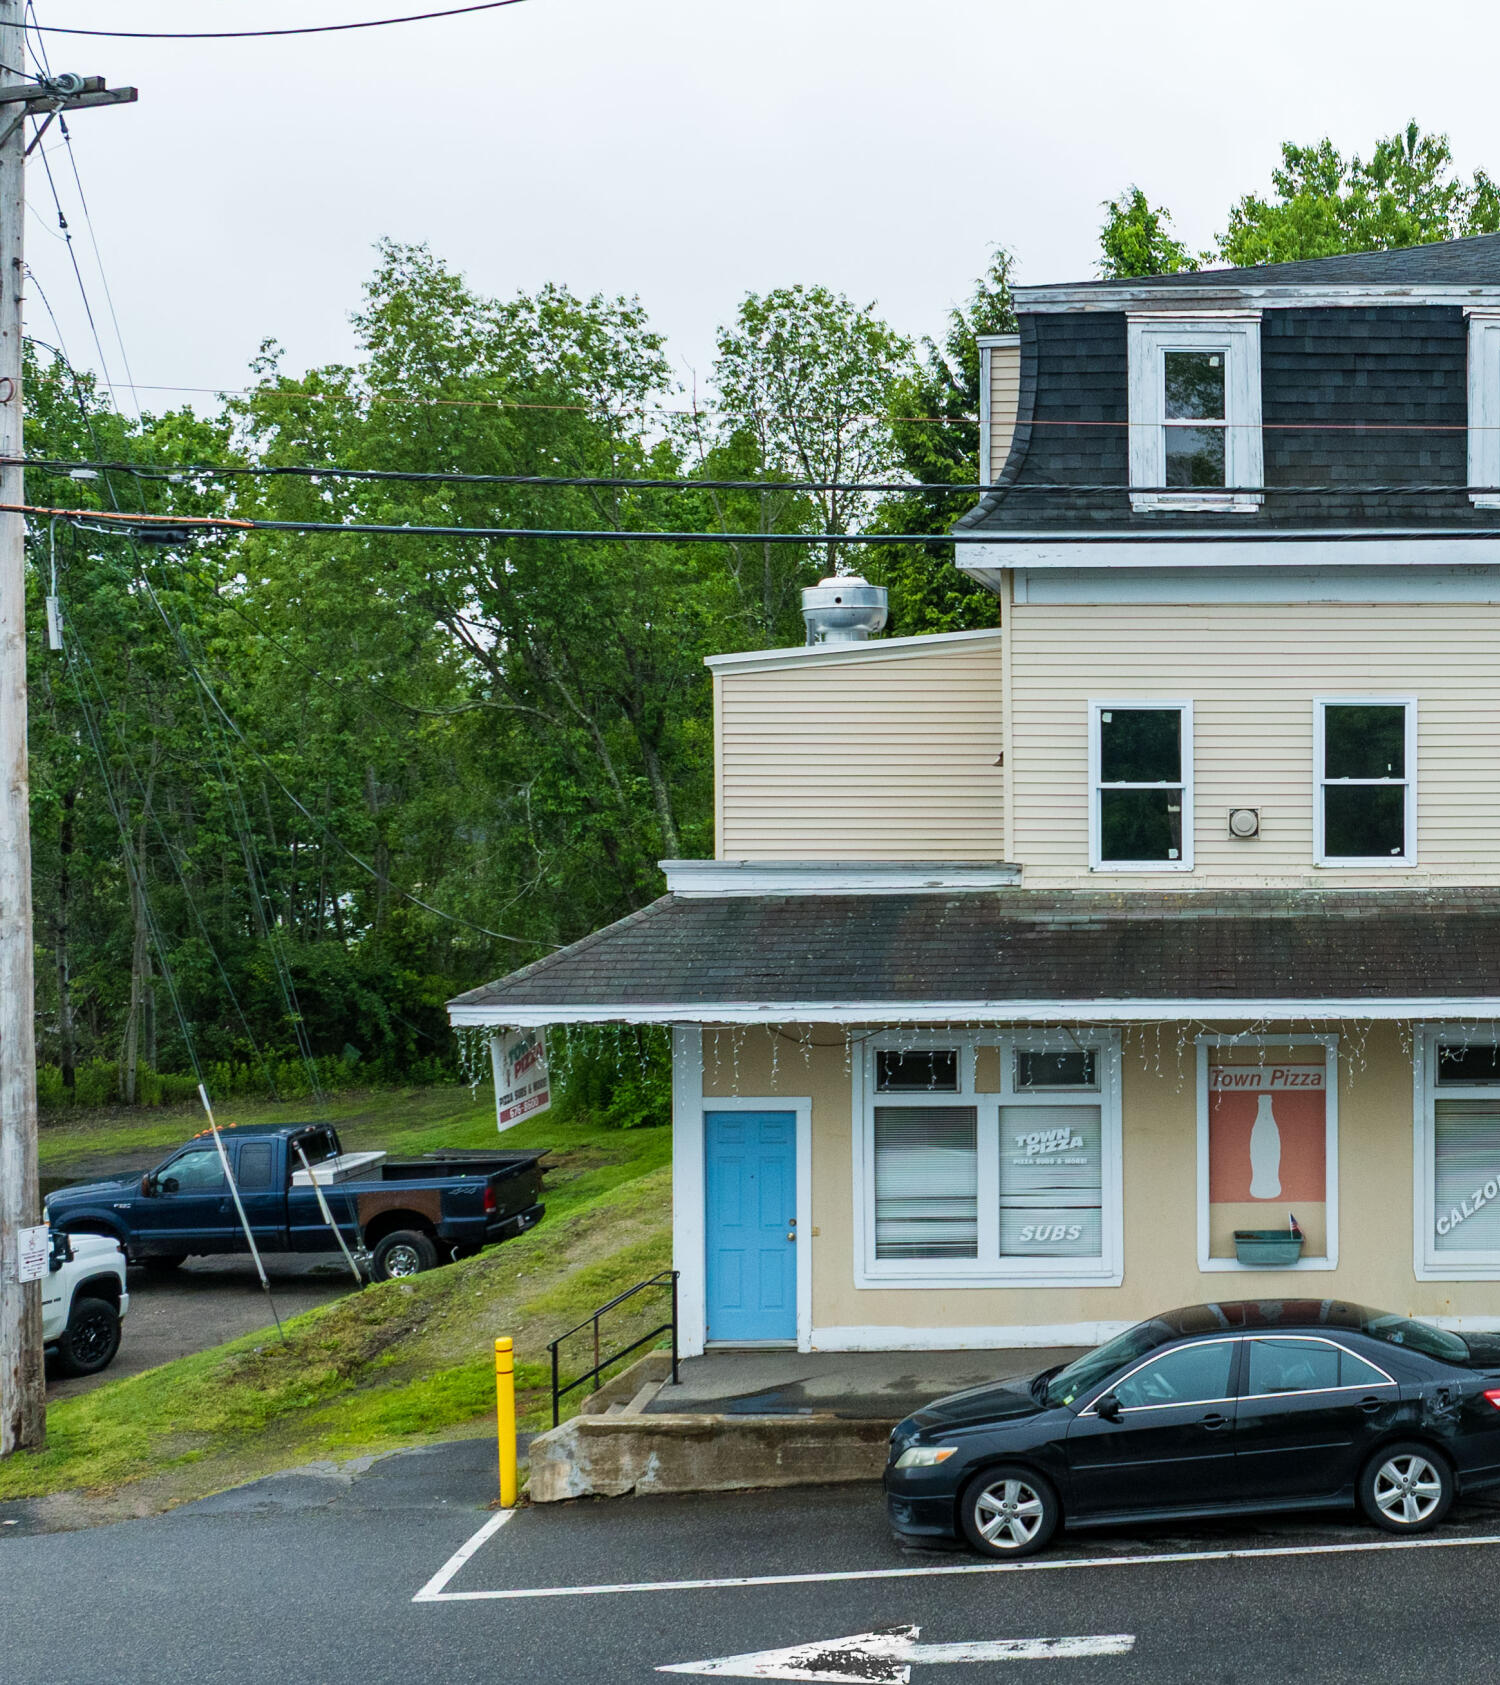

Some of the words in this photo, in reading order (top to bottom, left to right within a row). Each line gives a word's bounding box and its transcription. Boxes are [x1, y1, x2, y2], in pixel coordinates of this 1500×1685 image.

[1212, 1069, 1262, 1087] Town
[1270, 1069, 1322, 1087] Pizza
[1015, 1127, 1071, 1147] TOWN
[1026, 1136, 1083, 1156] PIZZA
[1020, 1224, 1082, 1241] SUBS
